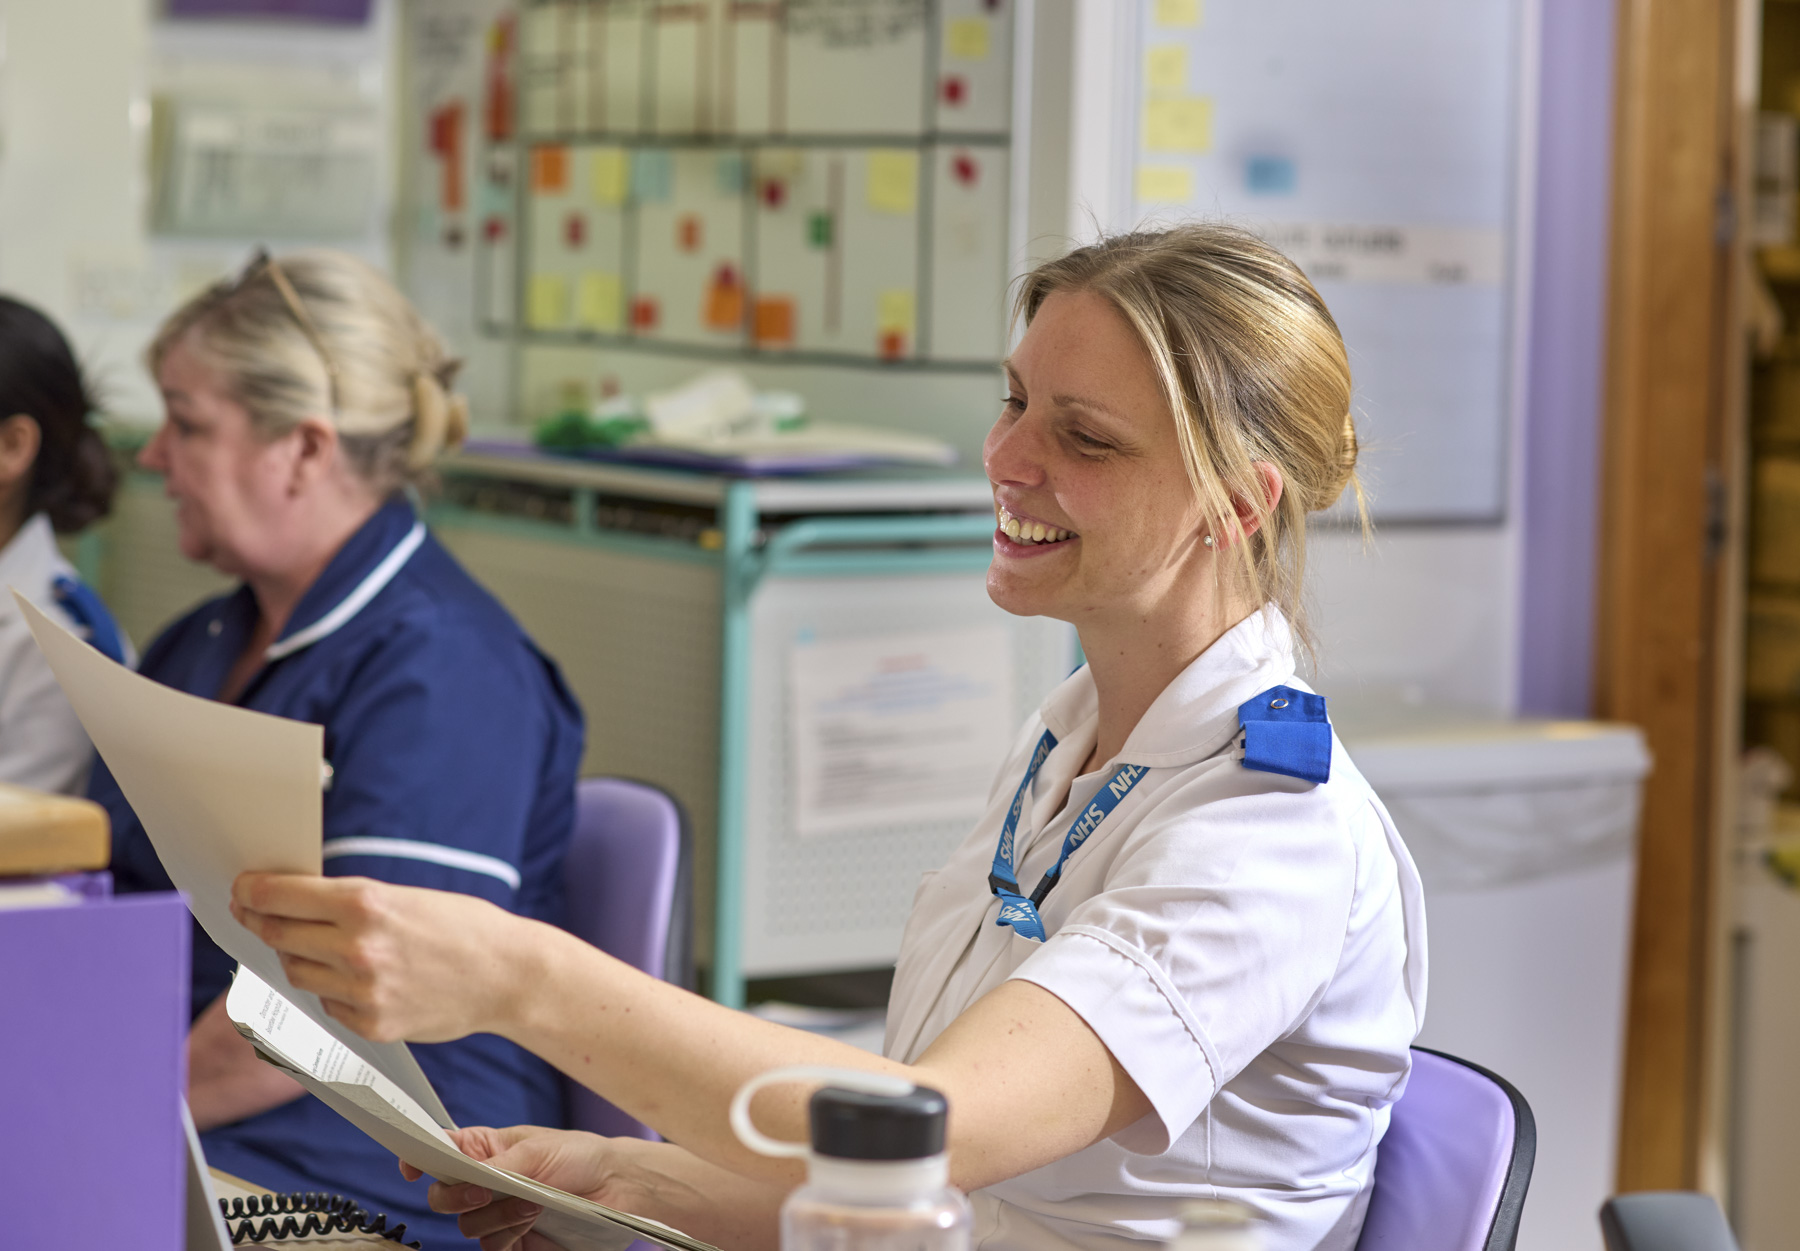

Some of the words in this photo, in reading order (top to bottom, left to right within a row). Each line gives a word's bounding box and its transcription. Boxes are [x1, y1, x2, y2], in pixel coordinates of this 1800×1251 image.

[1030, 739, 1050, 774] NHS
[1000, 825, 1013, 866] NHS
[1069, 803, 1105, 847] NHS
